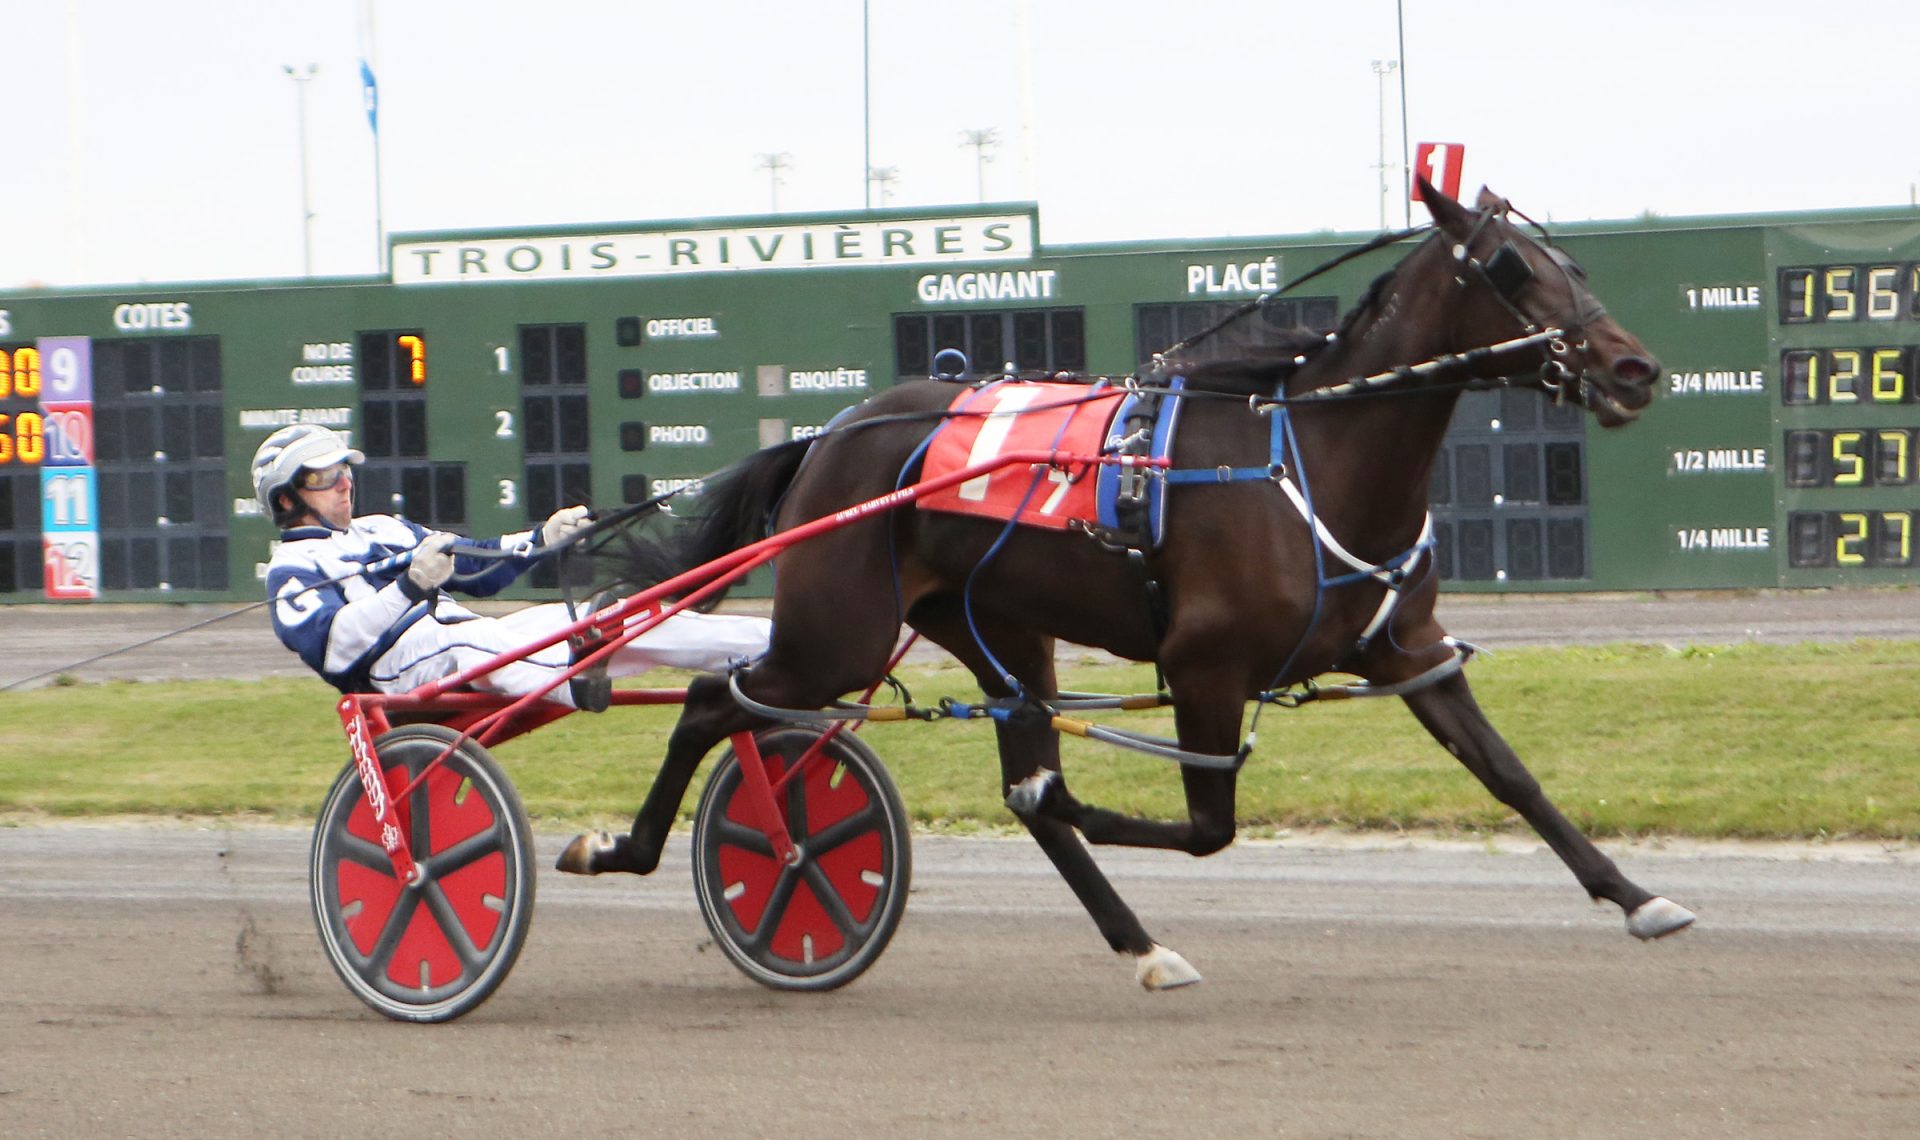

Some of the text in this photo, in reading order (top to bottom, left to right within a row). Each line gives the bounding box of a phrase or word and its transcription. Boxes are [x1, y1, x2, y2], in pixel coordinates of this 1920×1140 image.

[1426, 144, 1447, 193] 1
[411, 223, 1015, 275] TROIS-RIVIÈRES
[917, 270, 1056, 302] GAGNANT
[1187, 257, 1278, 294] PLACÉ
[1687, 286, 1760, 308] 1 MILLE
[113, 302, 191, 331] COTES
[646, 317, 717, 337] OFFICIEL
[303, 342, 354, 360] NO DE
[397, 335, 426, 385] 7
[494, 346, 509, 373] 1
[51, 347, 77, 394] 9
[291, 364, 354, 383] COURSE
[649, 371, 739, 391] OBJECTION
[790, 367, 867, 389] ENQUÊTE
[1671, 370, 1763, 393] 3/4 MILLE
[1807, 349, 1904, 401] 126
[239, 407, 354, 426] MINUTE AVANT
[495, 410, 514, 437] 2
[44, 411, 89, 460] 10
[650, 425, 707, 443] PHOTO
[958, 386, 1043, 502] 1
[1674, 448, 1766, 471] 1/2 MILLE
[46, 475, 88, 526] 11
[499, 479, 516, 506] 3
[1039, 471, 1076, 514] 7
[1677, 526, 1770, 549] 1/4 MILLE
[1836, 512, 1912, 565] 27
[46, 541, 94, 592] 12
